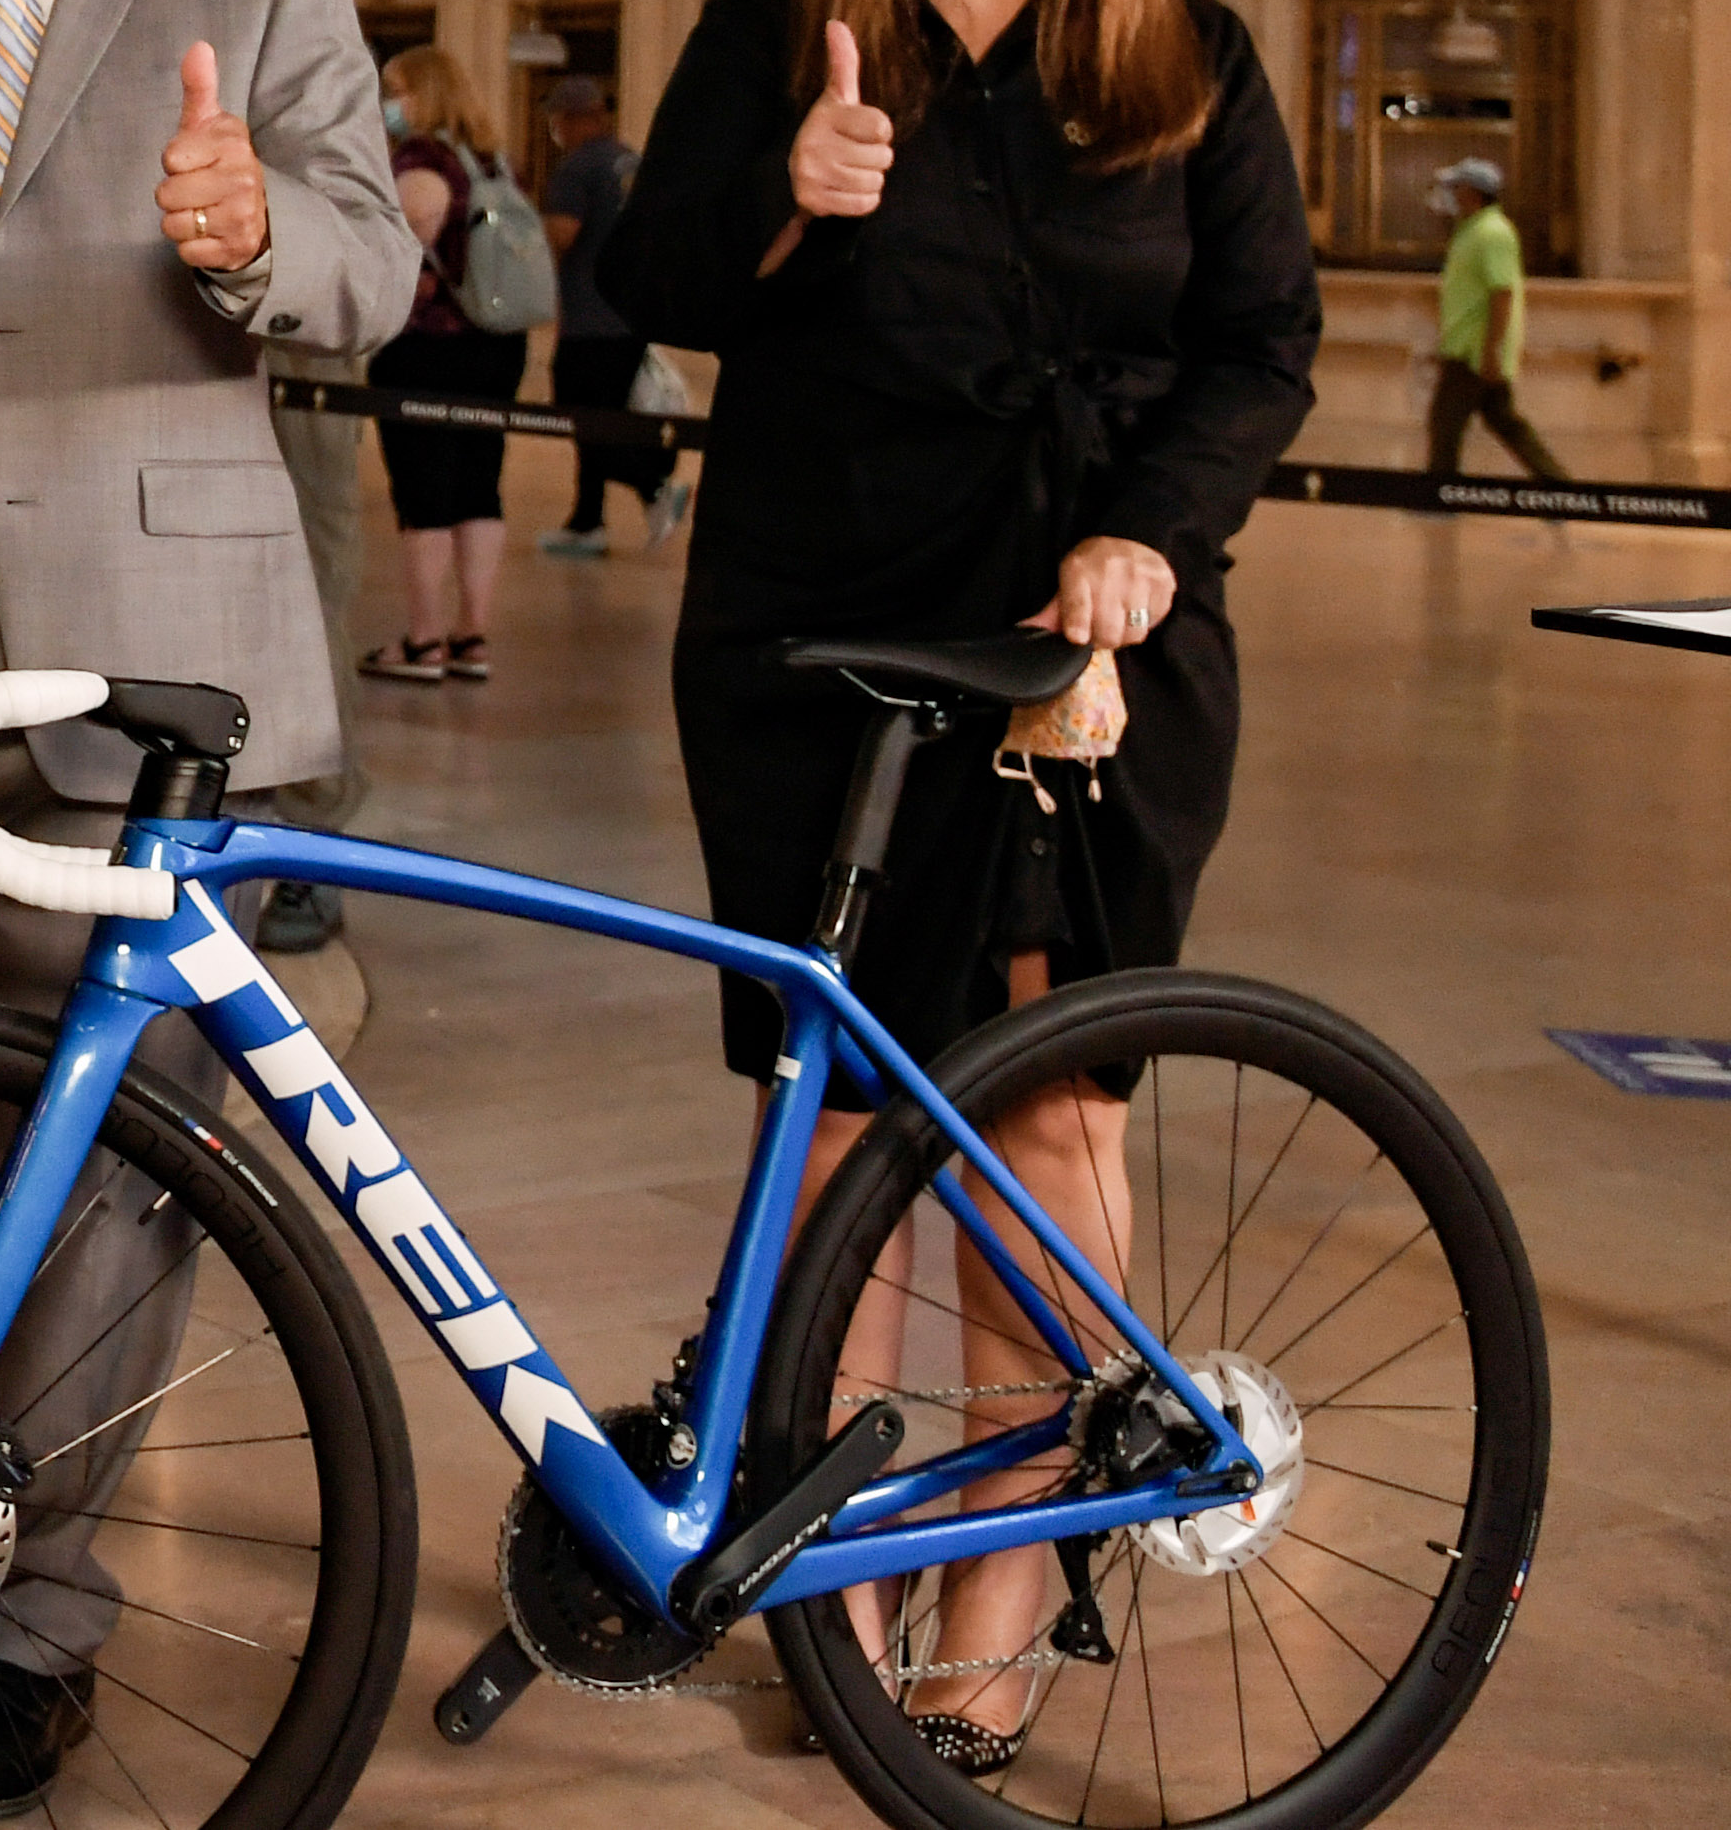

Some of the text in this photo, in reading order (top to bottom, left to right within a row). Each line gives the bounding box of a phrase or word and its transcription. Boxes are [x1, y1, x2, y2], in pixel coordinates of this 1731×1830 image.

[400, 399, 575, 432] GRAND CENTRAL TERMINAL
[1439, 483, 1709, 520] GRAND CENTRAL TERMINAL
[166, 877, 608, 1468] TREK
